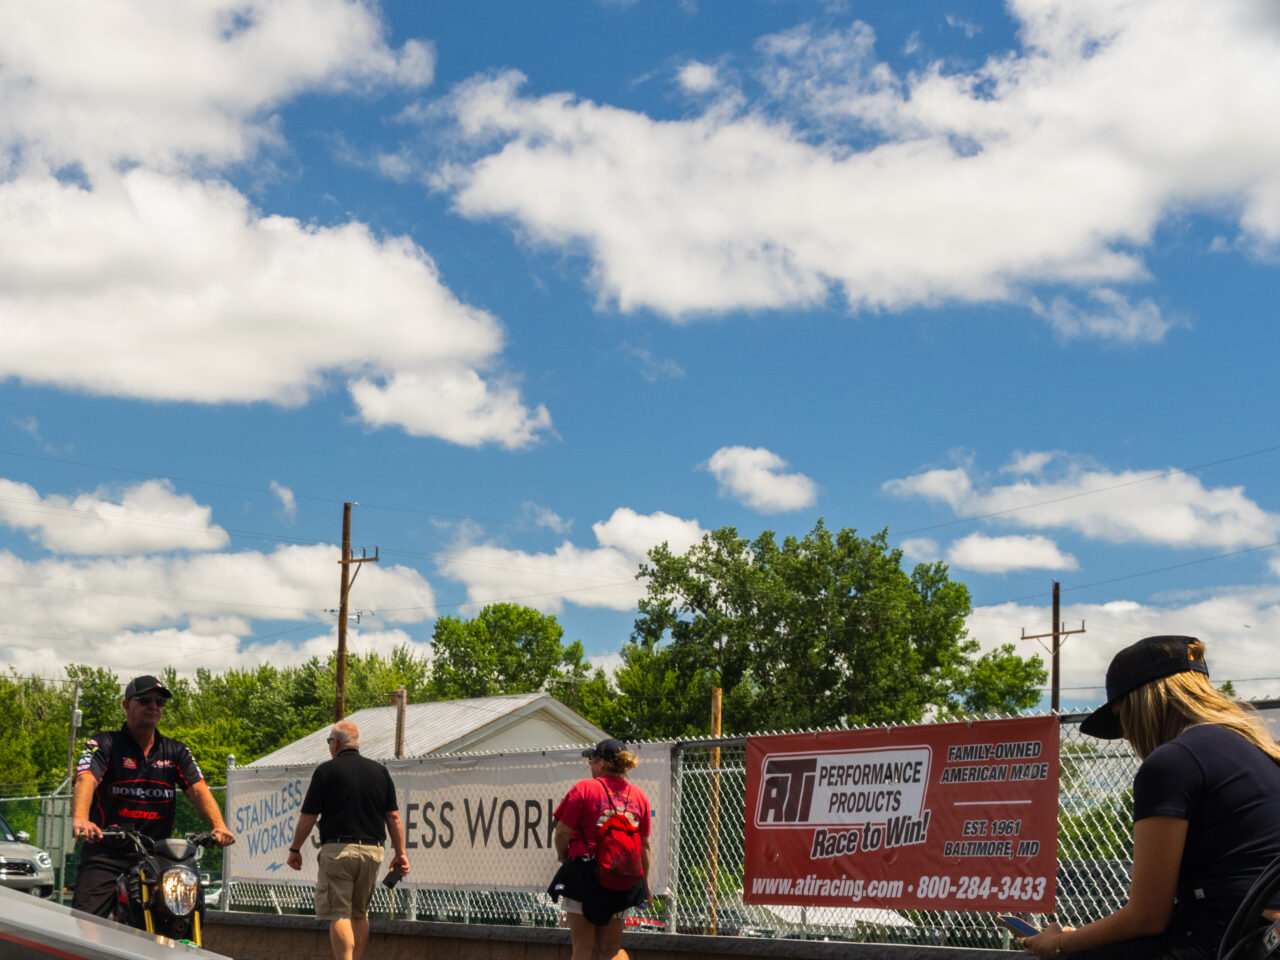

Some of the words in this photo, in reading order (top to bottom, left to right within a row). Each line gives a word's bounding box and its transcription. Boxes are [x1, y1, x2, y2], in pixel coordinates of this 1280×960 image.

[947, 741, 1042, 762] FAMILY-OWNED
[818, 761, 923, 787] PERFORMANCE
[940, 768, 1006, 784] AMERICAN
[1009, 763, 1049, 781] MADE
[759, 758, 818, 823] ATI
[828, 790, 902, 814] PRODUCTS
[235, 779, 303, 834] STAINLESS
[464, 797, 559, 849] WORK
[810, 826, 858, 860] Race
[861, 823, 881, 851] to
[884, 810, 931, 849] Win!
[962, 820, 987, 836] EST.
[990, 819, 1022, 836] 1961
[246, 815, 295, 859] WORKS
[944, 841, 1014, 860] BALTIMORE,
[1017, 840, 1041, 857] MD
[752, 874, 903, 901] www.atiracing.com
[917, 876, 1047, 900] 800-284-3433
